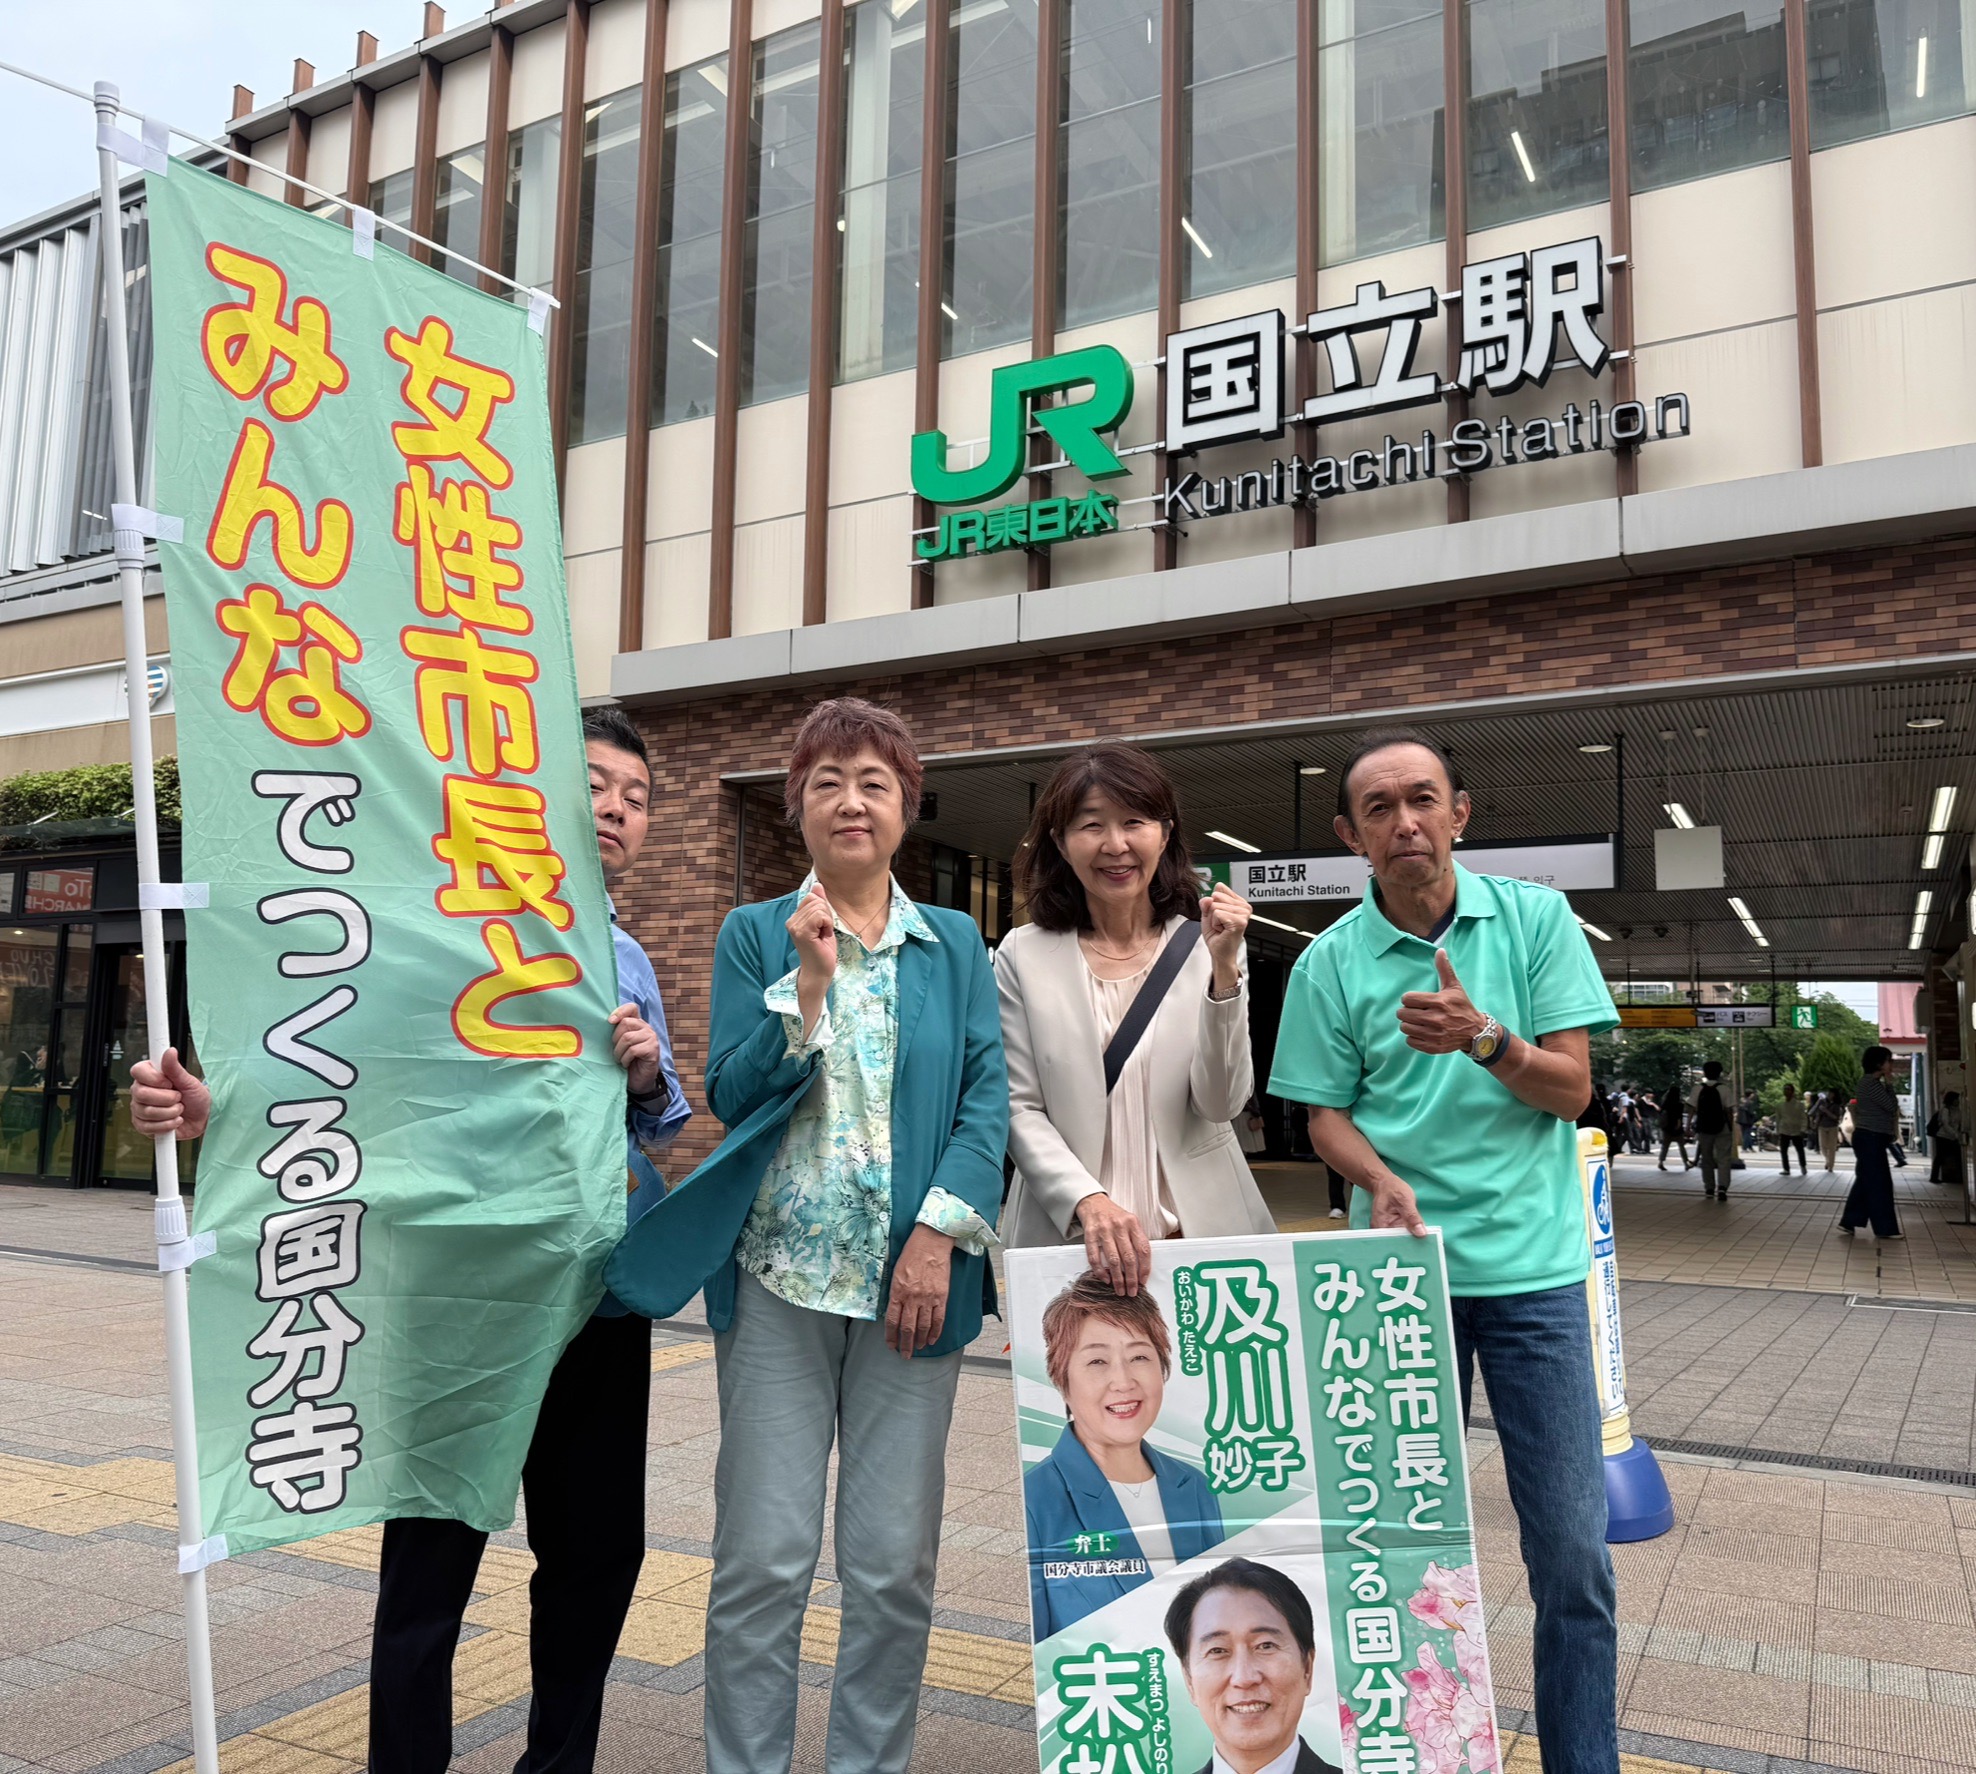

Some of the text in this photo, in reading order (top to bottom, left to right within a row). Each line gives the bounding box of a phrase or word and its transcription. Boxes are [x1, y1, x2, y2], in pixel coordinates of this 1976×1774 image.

[1165, 234, 1611, 454] 国立駅
[911, 344, 1134, 507] JR
[1164, 392, 1691, 519] Kunitachi Station
[916, 489, 1120, 562] JR東日本
[385, 315, 583, 1059] 女性市長と
[200, 241, 372, 1514] みんなでつくる国分寺
[1192, 866, 1212, 891] R
[1248, 864, 1306, 884] 国立駅
[1248, 885, 1350, 897] Kunitachi Station
[1176, 1270, 1199, 1373] おいかわ たえこ
[1371, 1256, 1449, 1531] 女性市長と
[1044, 1558, 1146, 1578] 国分寺市議会議員
[1074, 1533, 1112, 1555] 弁士
[1146, 1651, 1165, 1713] すえまつ
